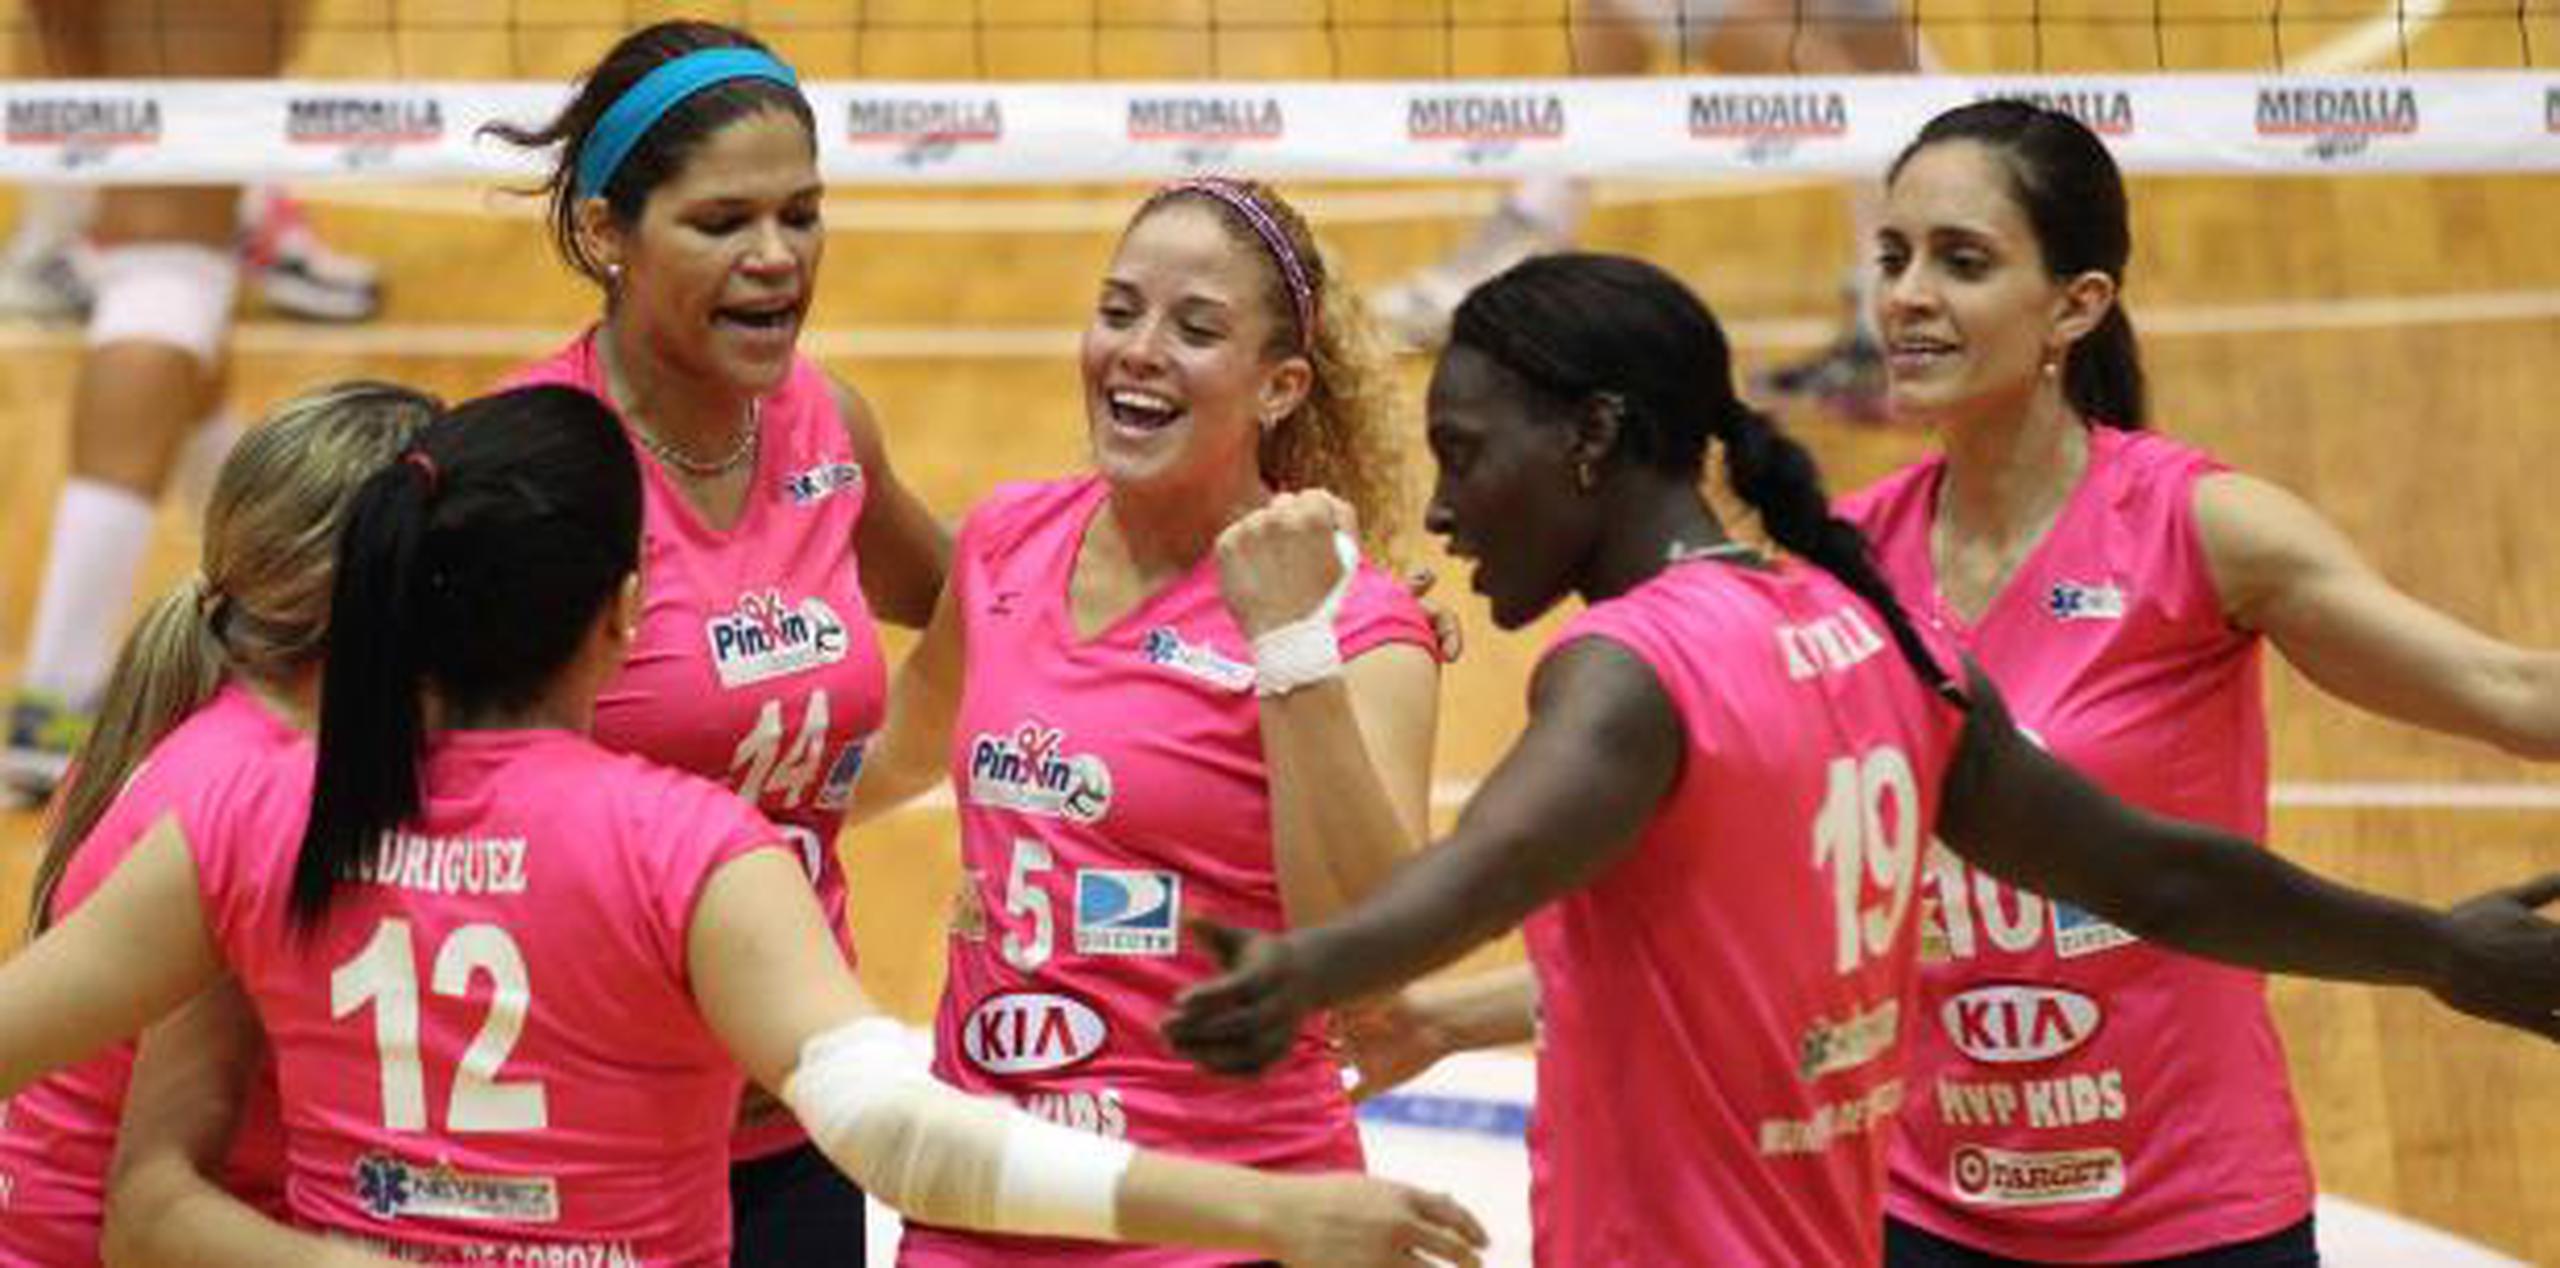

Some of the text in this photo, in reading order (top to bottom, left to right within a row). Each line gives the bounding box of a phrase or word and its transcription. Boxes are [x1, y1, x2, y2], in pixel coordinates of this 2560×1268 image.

[5, 99, 161, 134] MEDALLA
[286, 98, 441, 133] MEDALLA
[848, 99, 1002, 135] MEDALLA
[1127, 98, 1283, 135] MEDALLA
[1407, 97, 1564, 134] MEDALLA
[1688, 93, 1847, 129] MEDALLA
[2256, 88, 2417, 126] MEDALLA
[730, 689, 828, 808] 14
[340, 830, 527, 893] DRIGUEZ
[1812, 745, 1920, 976] 19
[1002, 838, 1053, 972] 5
[331, 917, 548, 1132] 12
[979, 1005, 1078, 1061] KIA
[1958, 998, 2075, 1049] KIA
[1938, 1077, 2017, 1126] MVP
[2023, 1069, 2126, 1128] KIDS
